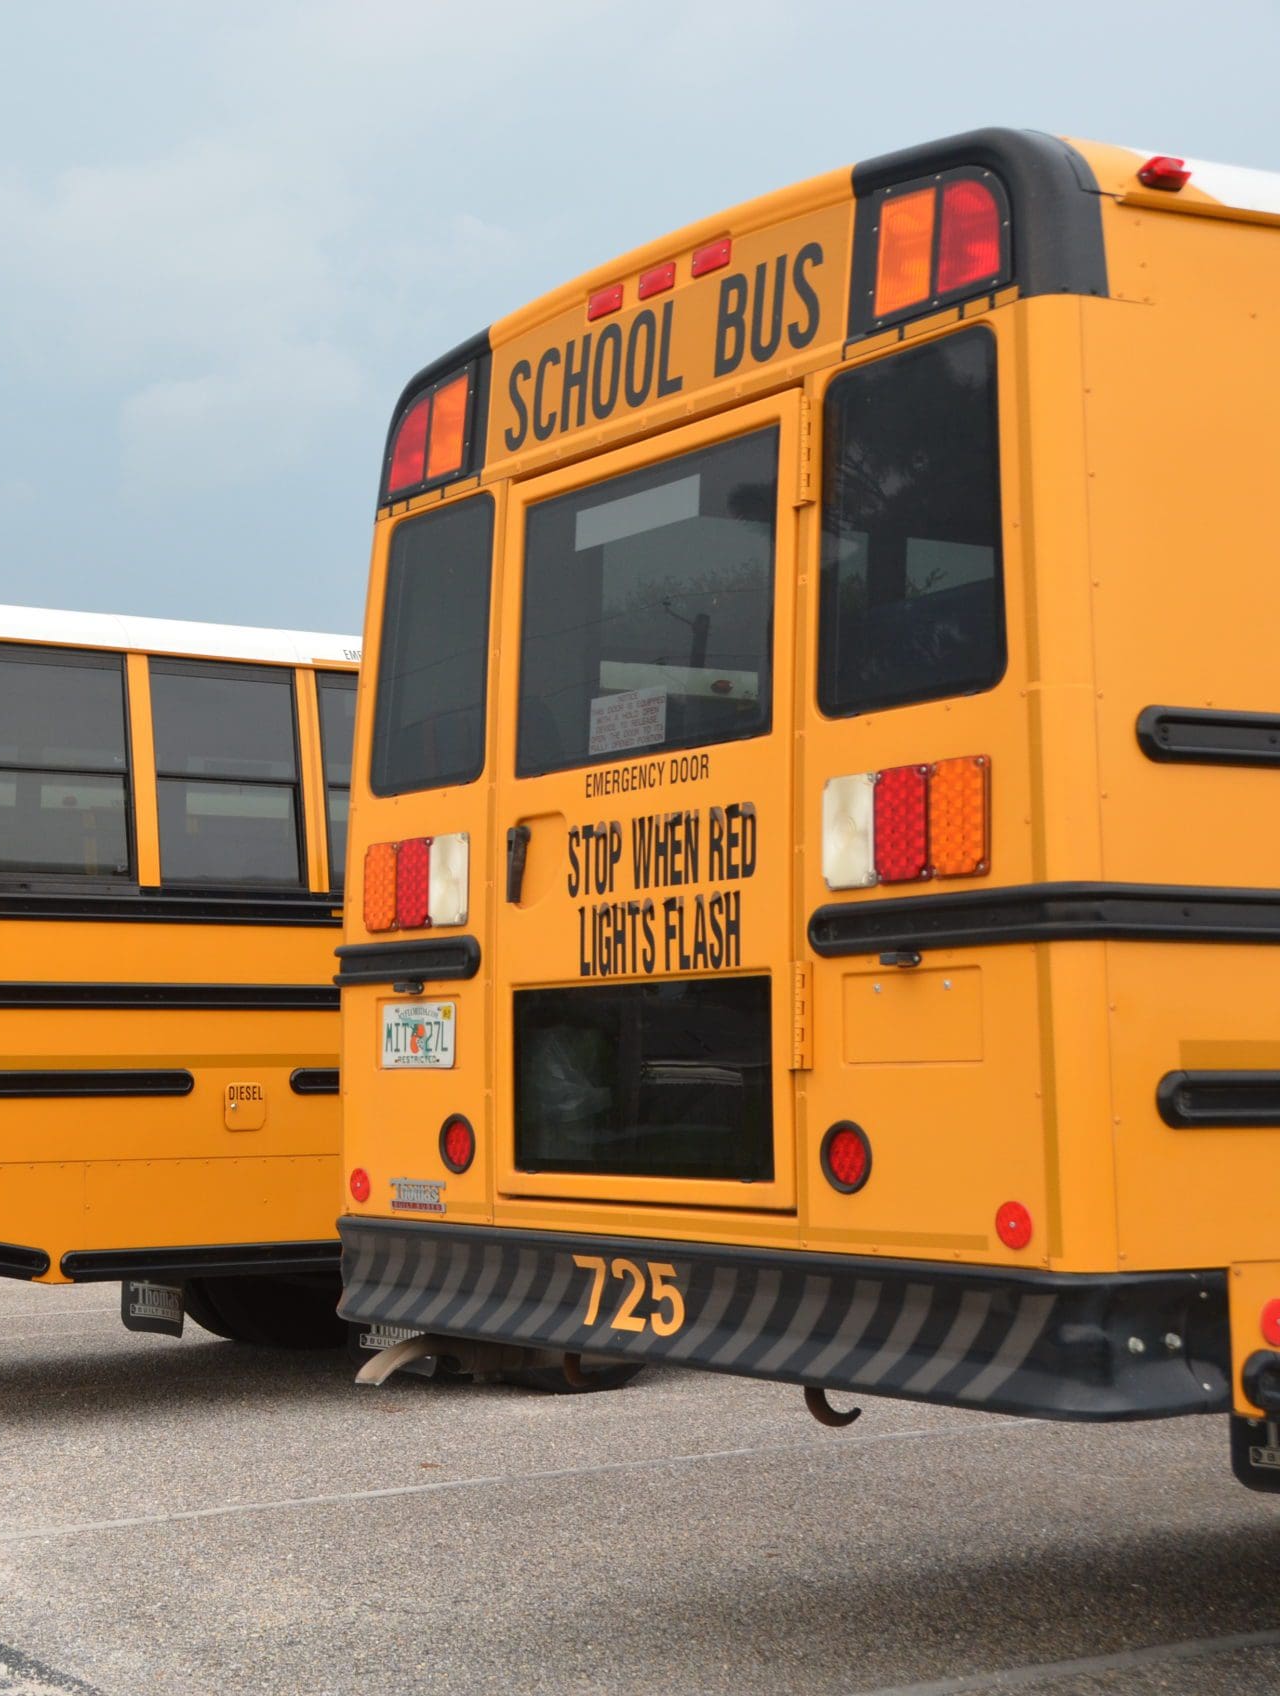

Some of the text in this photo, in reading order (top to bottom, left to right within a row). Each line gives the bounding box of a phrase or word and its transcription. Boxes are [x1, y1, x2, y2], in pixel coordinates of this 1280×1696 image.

[504, 242, 824, 452] SCHOOL BUS
[585, 753, 709, 799] EMERGENCY DOOR
[567, 801, 757, 898] STOP WHEN RED
[579, 890, 741, 977] LIGHTS FLASH
[228, 1085, 263, 1101] DIESEL
[397, 1055, 438, 1064] RESTRICTED
[572, 1255, 686, 1337] 725
